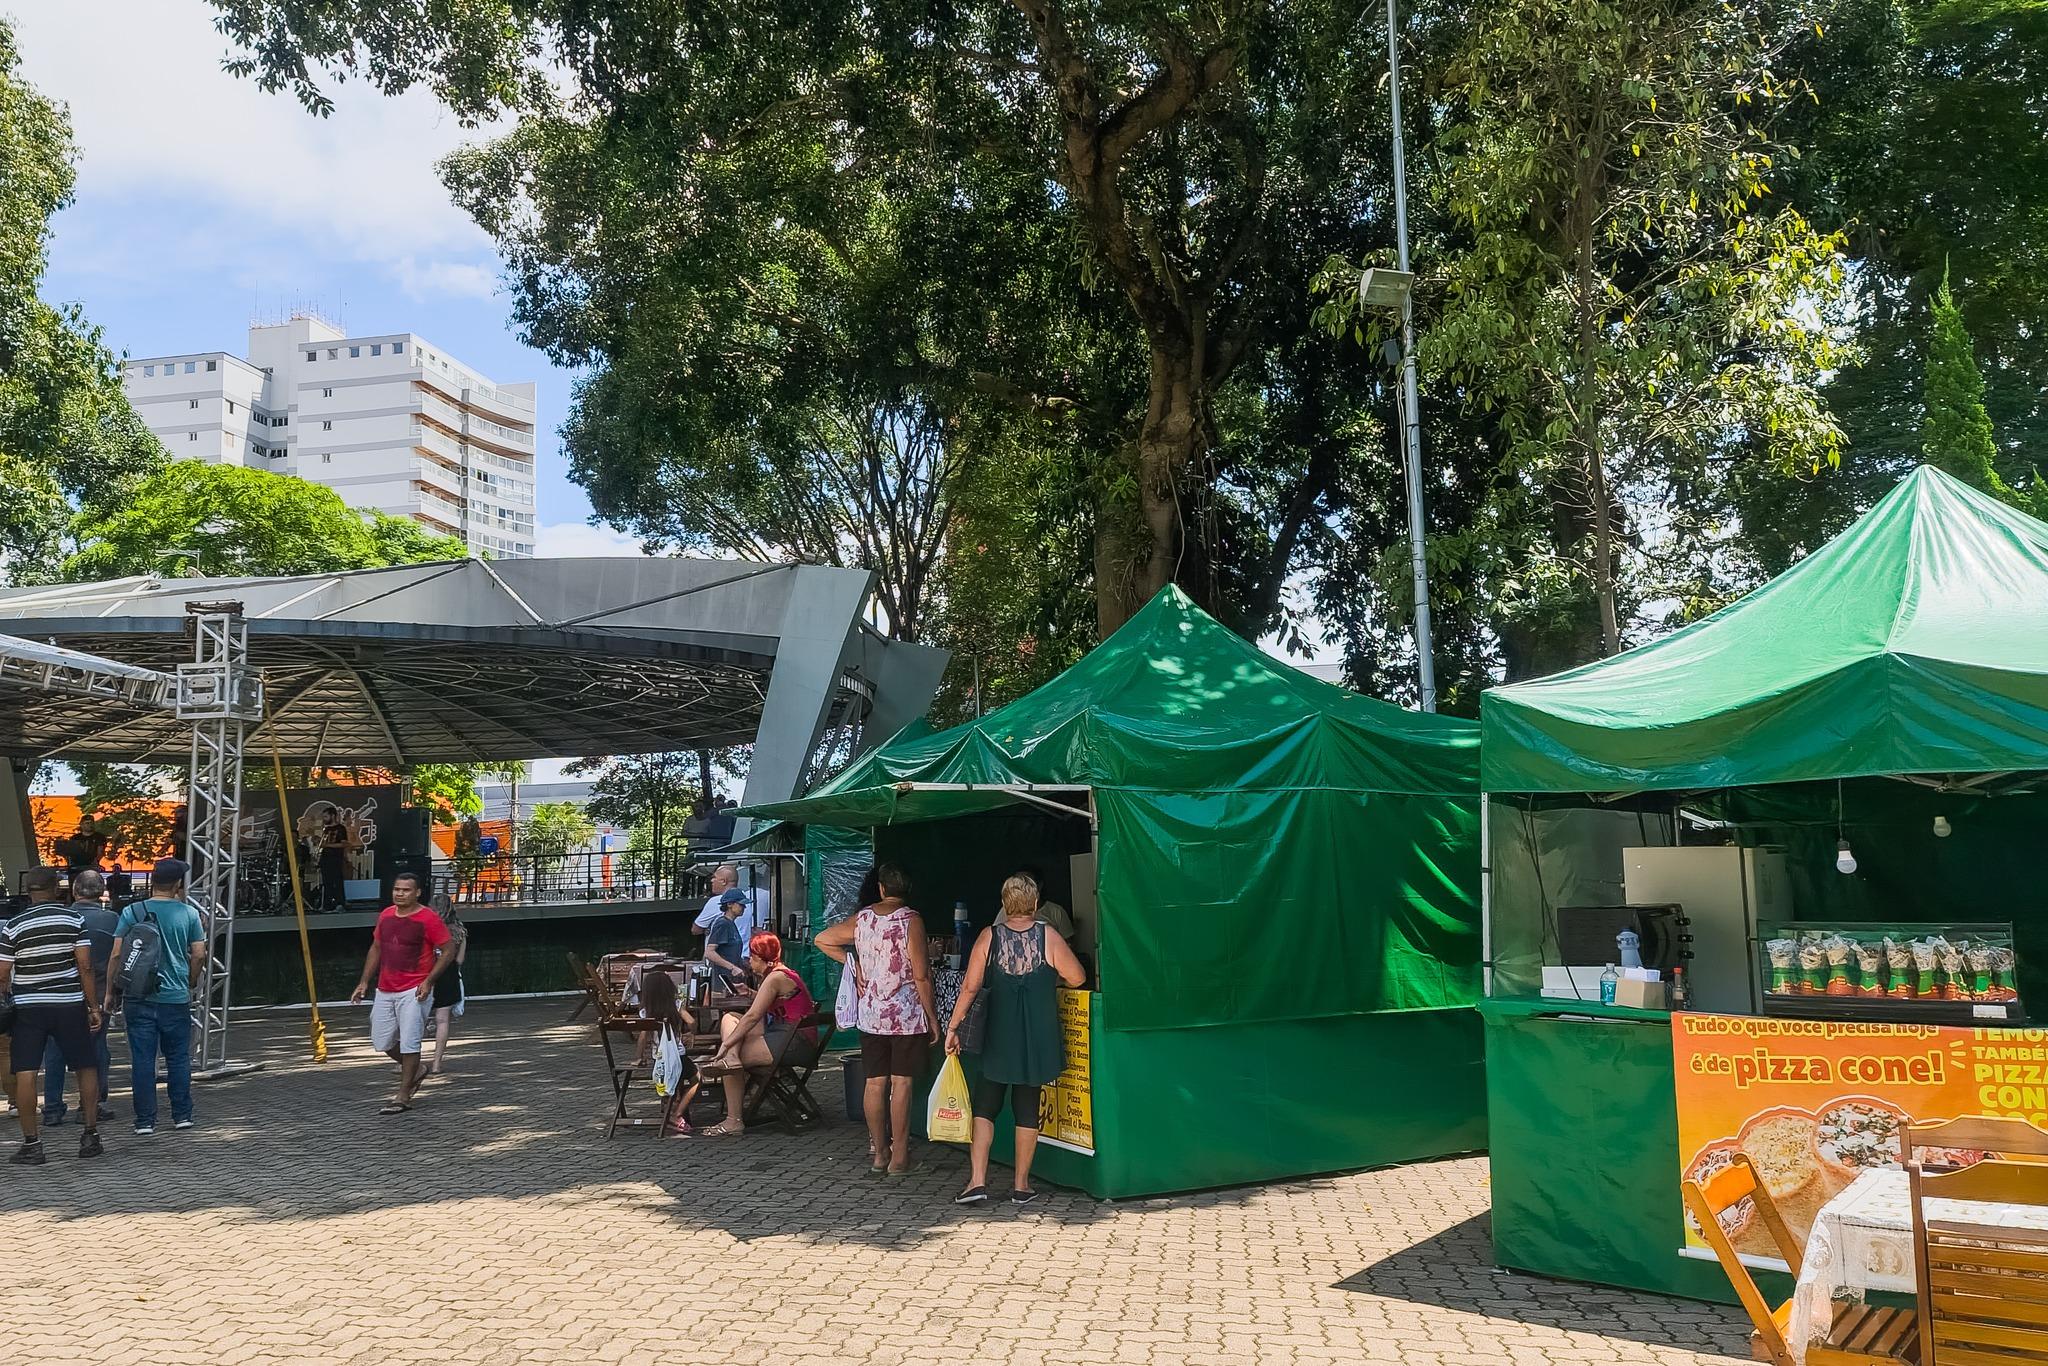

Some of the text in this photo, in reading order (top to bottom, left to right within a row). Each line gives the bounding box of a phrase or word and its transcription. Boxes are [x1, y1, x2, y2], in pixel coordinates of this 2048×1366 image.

[1064, 1026, 1083, 1038] Frango
[1684, 1017, 1729, 1033] Tudo
[1731, 1020, 1743, 1033] o
[1745, 1020, 1779, 1037] que
[1826, 1022, 1893, 1038] precisa
[1974, 1028, 2048, 1042] TEMO
[1972, 1044, 2048, 1061] TAMBÉ
[1691, 1049, 1944, 1087] é de pizza cone!
[1067, 1092, 1081, 1104] Pizza
[1979, 1085, 2048, 1110] CON
[1066, 1104, 1083, 1118] Queijo
